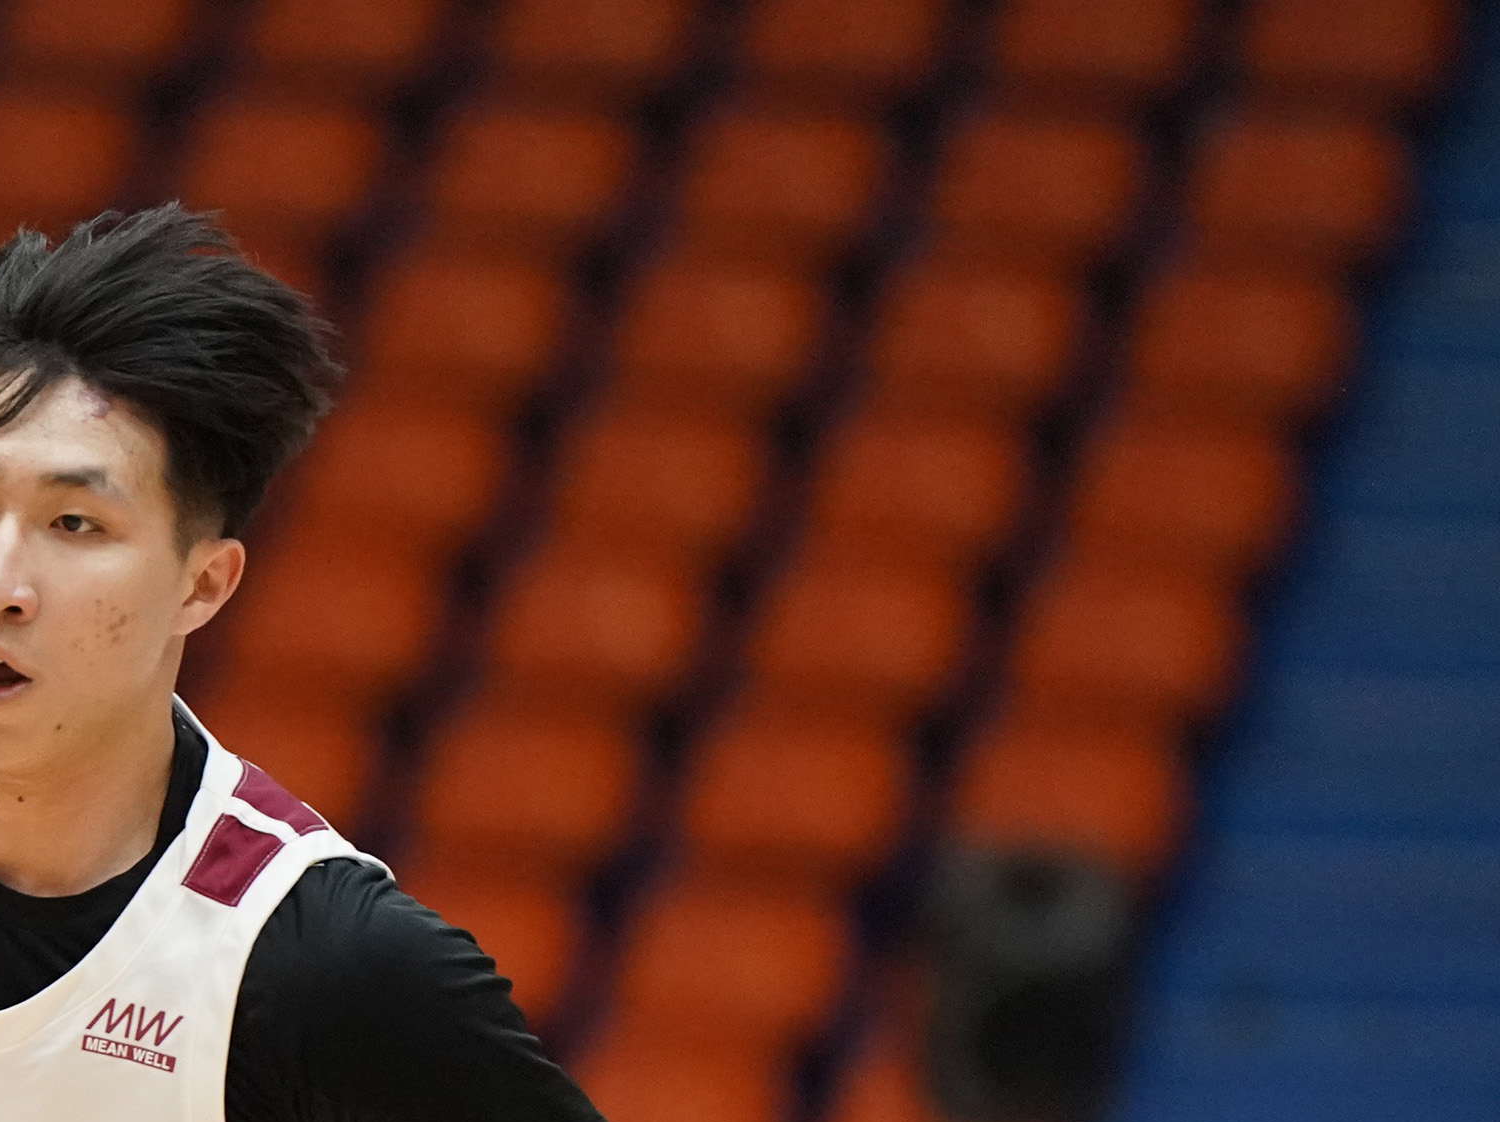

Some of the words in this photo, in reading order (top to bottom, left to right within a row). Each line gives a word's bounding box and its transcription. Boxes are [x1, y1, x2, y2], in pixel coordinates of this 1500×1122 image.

[85, 998, 184, 1047] MW
[85, 1037, 128, 1058] MEAN
[132, 1047, 171, 1070] WELL
